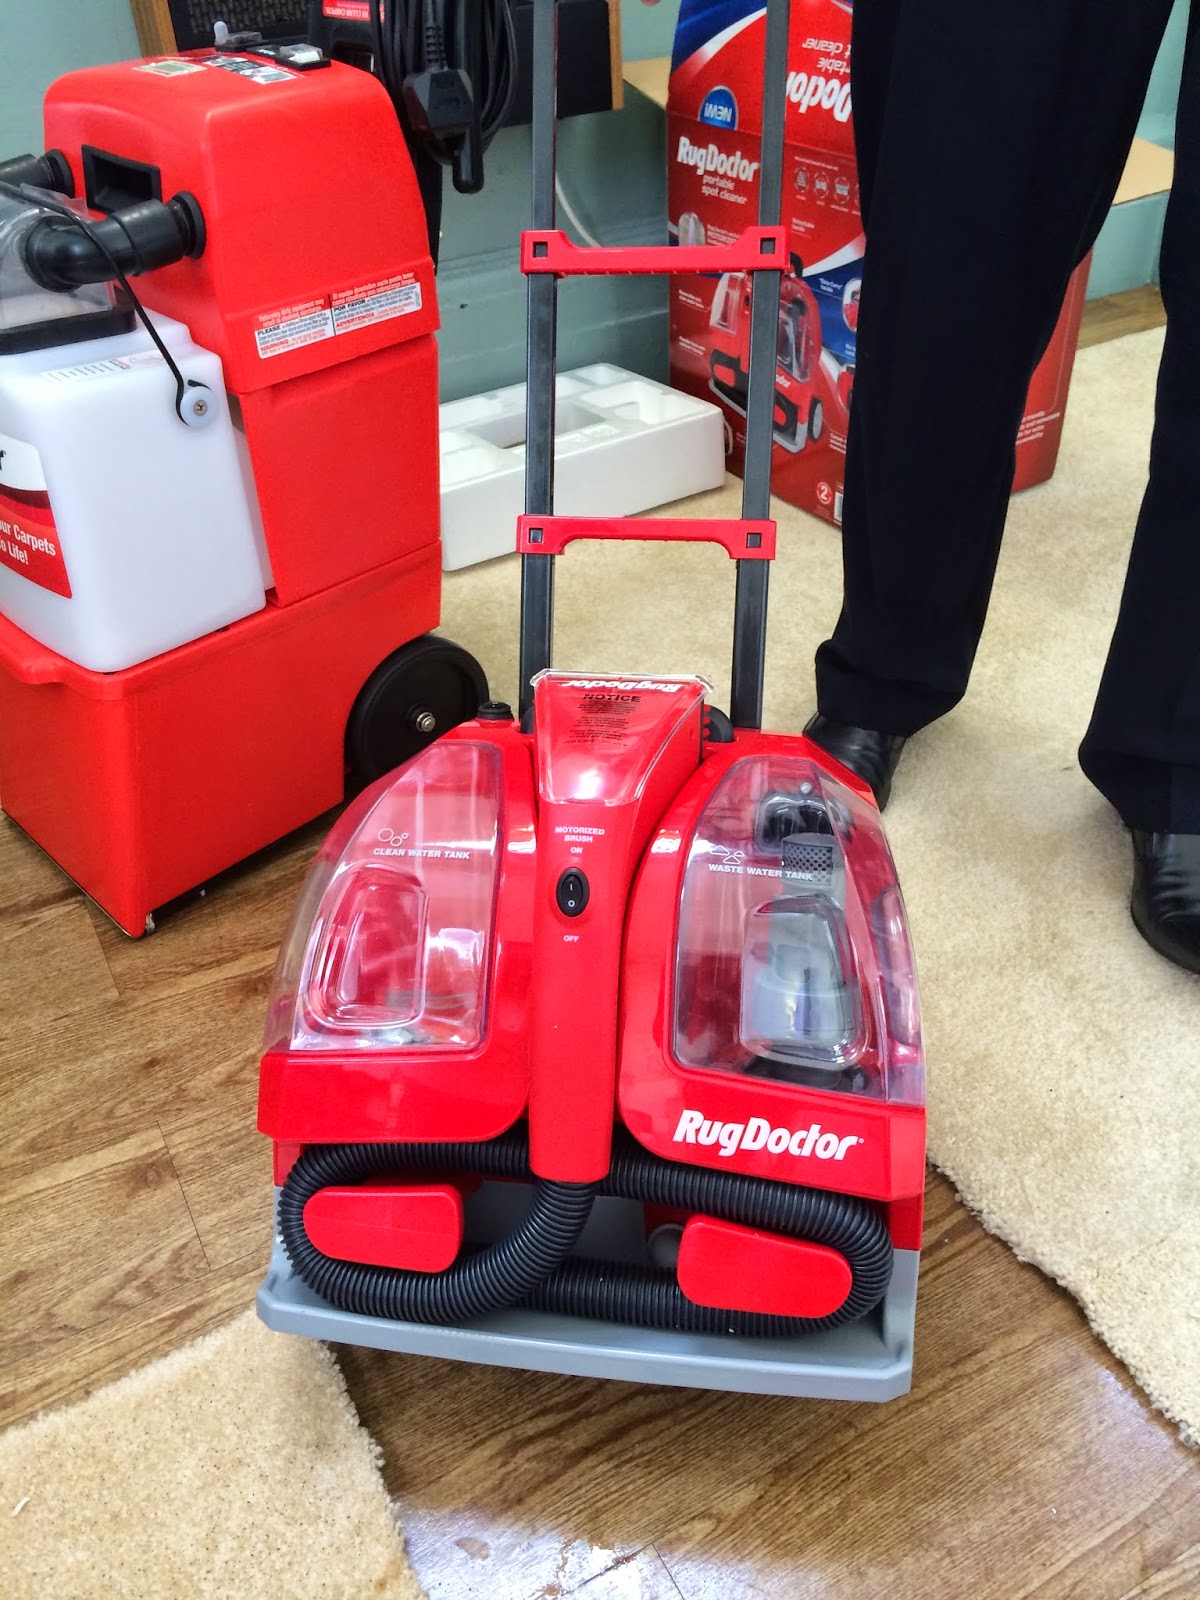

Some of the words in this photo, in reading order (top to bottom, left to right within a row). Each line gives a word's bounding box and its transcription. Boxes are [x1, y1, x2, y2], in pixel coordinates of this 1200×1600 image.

[802, 37, 843, 53] cleaner
[704, 102, 733, 122] NEW!
[677, 136, 759, 182] RugDoctor
[702, 175, 735, 190] portable
[701, 185, 719, 197] spot
[720, 190, 748, 205] cleaner
[334, 304, 346, 313] POR
[347, 299, 366, 309] FAVOR
[336, 312, 375, 327] ADVERTENCIA
[257, 324, 281, 336] PLEASE
[260, 339, 289, 352] WARNING
[13, 524, 56, 557] Carpets
[7, 540, 29, 565] Life!
[561, 679, 683, 693] RugDoctor
[583, 693, 642, 702] NOTICE
[555, 826, 605, 835] MOTORIZED
[564, 835, 593, 843] BRUSH
[373, 848, 406, 857] CLEAN
[407, 850, 441, 858] WATER
[444, 851, 470, 860] TANK
[708, 864, 743, 874] WASTE
[747, 868, 782, 877] WATER
[785, 871, 813, 880] TANK
[672, 1109, 859, 1161] RugDoctor
